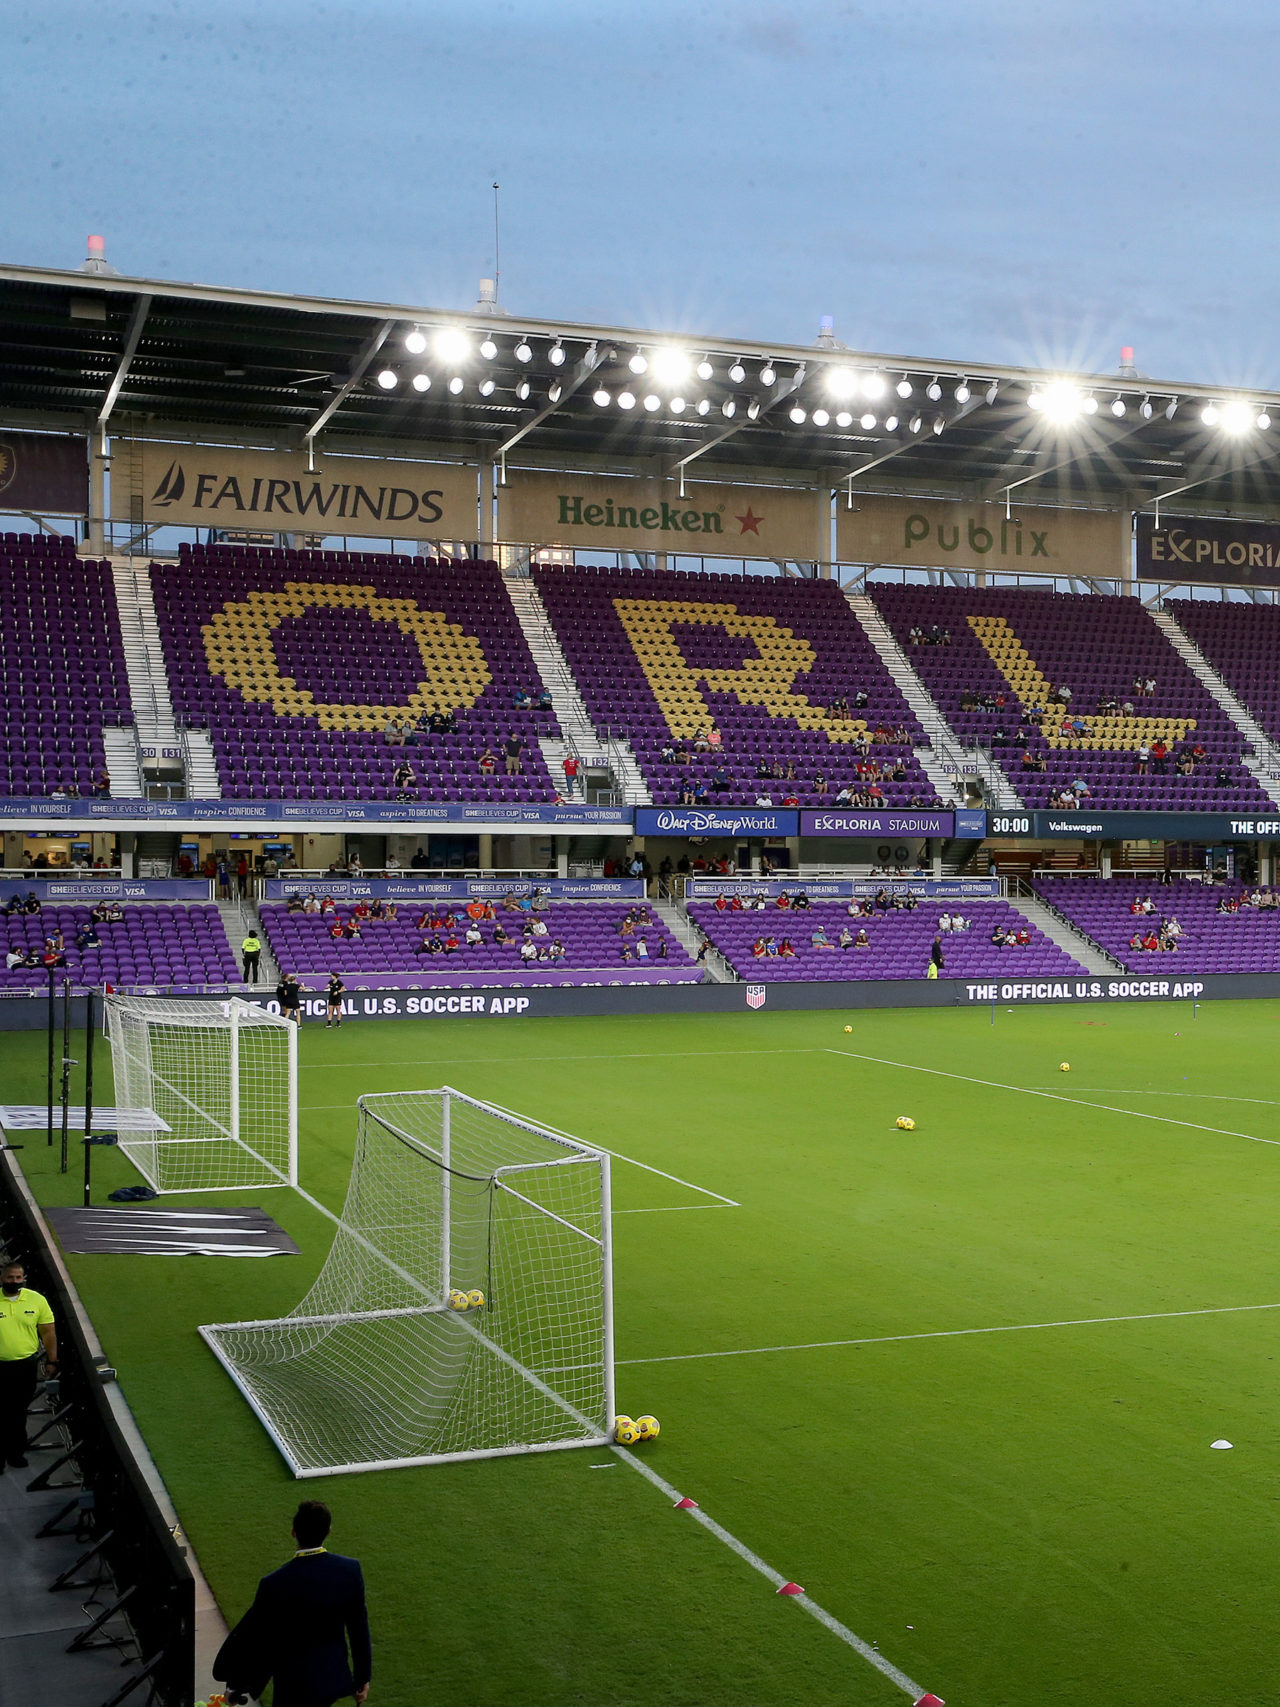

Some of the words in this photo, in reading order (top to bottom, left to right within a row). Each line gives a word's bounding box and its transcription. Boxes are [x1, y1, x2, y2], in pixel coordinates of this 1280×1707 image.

[192, 473, 443, 523] FAIRWINDS
[557, 495, 723, 534] Heineken
[905, 514, 1049, 558] Publix
[143, 748, 155, 757] 30
[163, 748, 180, 757] 131
[593, 758, 607, 766] 132
[963, 766, 977, 774] 133
[30, 804, 38, 813] IN
[38, 804, 72, 813] YOURSELF
[92, 805, 138, 813] SHEBELIEVES
[139, 805, 154, 813] CUP
[194, 807, 227, 817] inspire
[228, 807, 266, 816] CONFIDENCE
[285, 807, 328, 815] SHEBELIEVES
[465, 809, 504, 817] SHEBELIEVES
[347, 810, 365, 818] VISA
[380, 810, 407, 818] aspire
[408, 809, 416, 817] TO
[416, 809, 448, 817] GREATNESS
[554, 813, 583, 821] pursue
[584, 812, 599, 820] YOUR
[599, 812, 622, 820] PASSION
[814, 815, 882, 831] EXPLORIA
[888, 820, 940, 831] STADIUM
[992, 818, 1029, 833] 30:00
[1049, 821, 1103, 833] Volkswagen
[1231, 821, 1254, 834] THE
[51, 886, 102, 894] SHEBELIEVES
[125, 888, 146, 896] VISA
[284, 885, 331, 893] SHEBELIEVES
[332, 885, 347, 893] CUP
[352, 887, 371, 895] VISA
[387, 885, 416, 893] believe
[418, 884, 425, 892] IN
[425, 884, 452, 892] YOURSELF
[470, 884, 514, 893] SHEBELIEVES
[515, 884, 529, 892] CUP
[562, 884, 590, 892] inspire
[590, 883, 622, 892] CONFIDENCE
[694, 885, 734, 893] SHEBELIEVES
[752, 887, 769, 895] VISA
[960, 884, 973, 892] YOUR
[974, 884, 992, 892] PASSION
[747, 986, 764, 996] USA
[966, 984, 998, 1000] THE
[1001, 982, 1072, 999] OFFICIAL
[1075, 982, 1105, 997] U.S.
[1108, 981, 1169, 997] SOCCER
[1172, 982, 1204, 997] APP
[363, 998, 401, 1015] U.S.
[406, 996, 485, 1014] SOCCER
[489, 997, 530, 1014] APP
